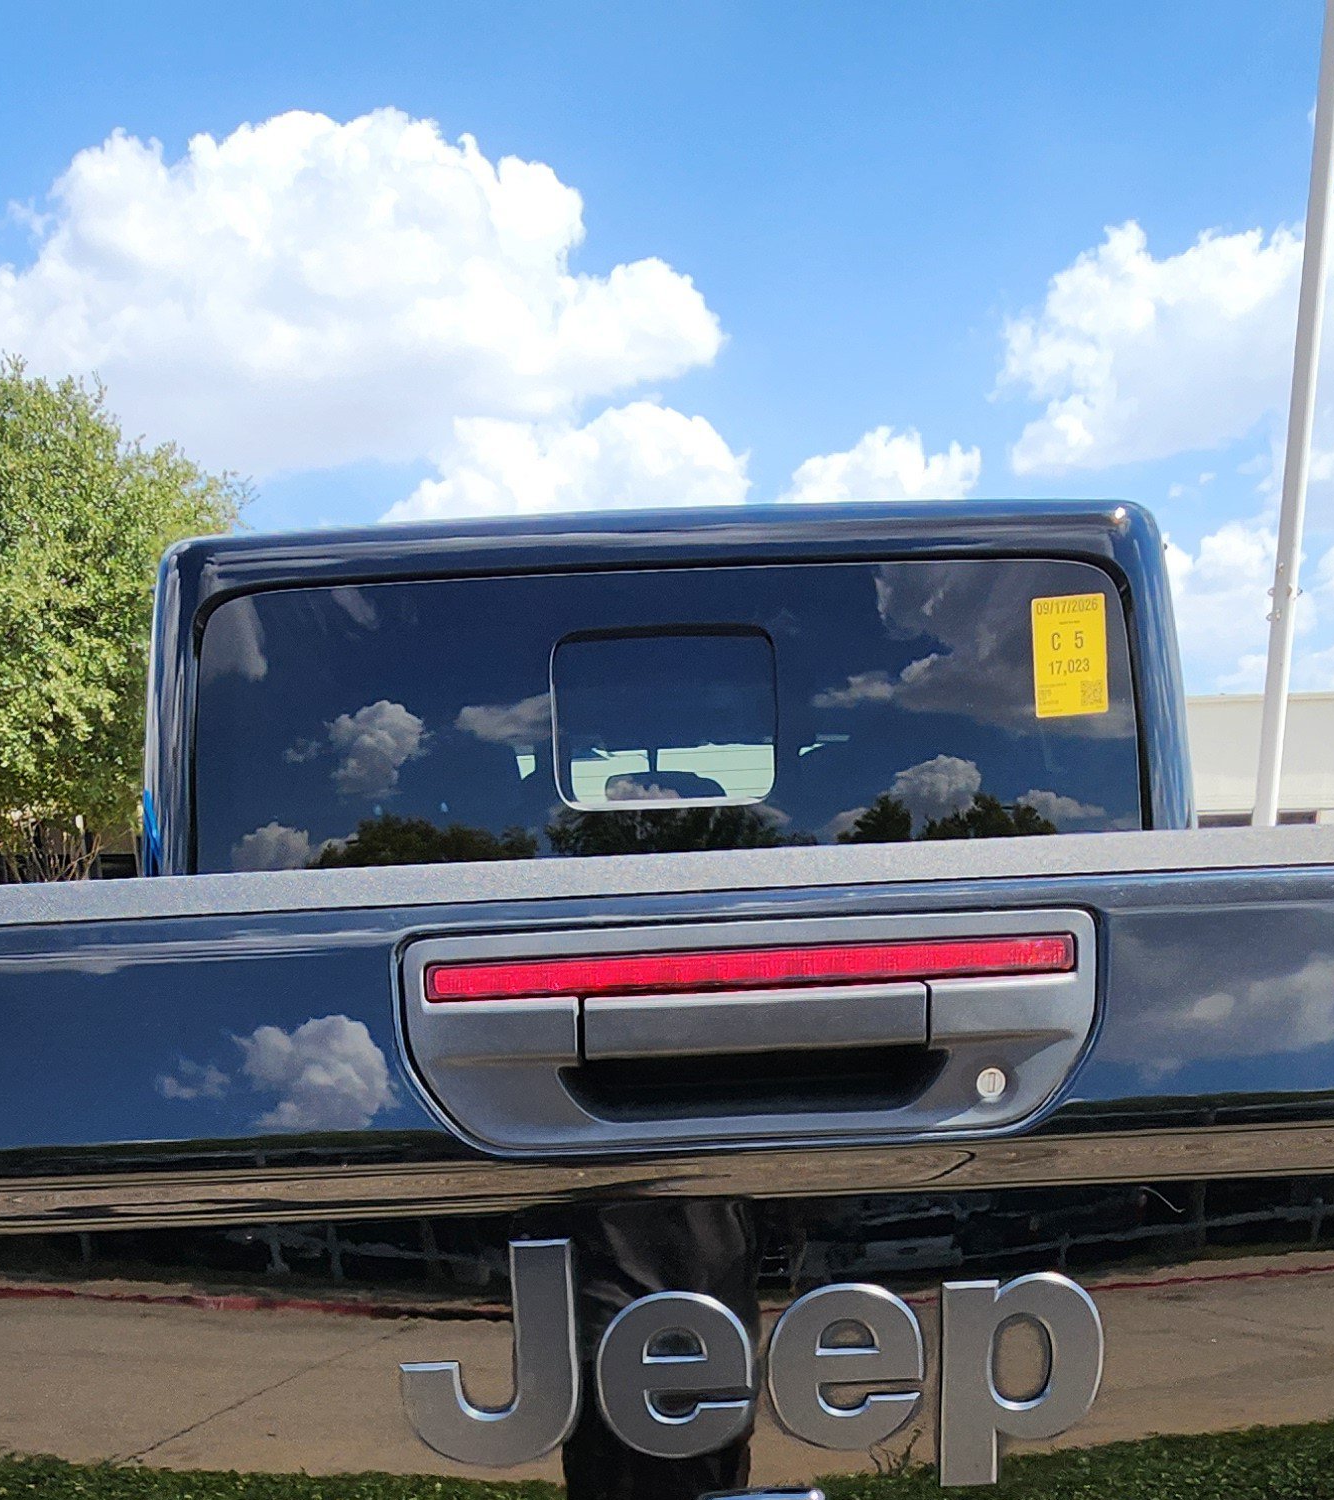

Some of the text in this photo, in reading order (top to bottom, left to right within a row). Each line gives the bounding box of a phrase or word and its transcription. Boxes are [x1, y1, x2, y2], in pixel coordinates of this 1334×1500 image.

[1036, 599, 1098, 615] 09/17/2026
[1051, 631, 1084, 650] C 5
[1049, 658, 1090, 676] 17,023
[399, 1238, 1105, 1487] Jeep
